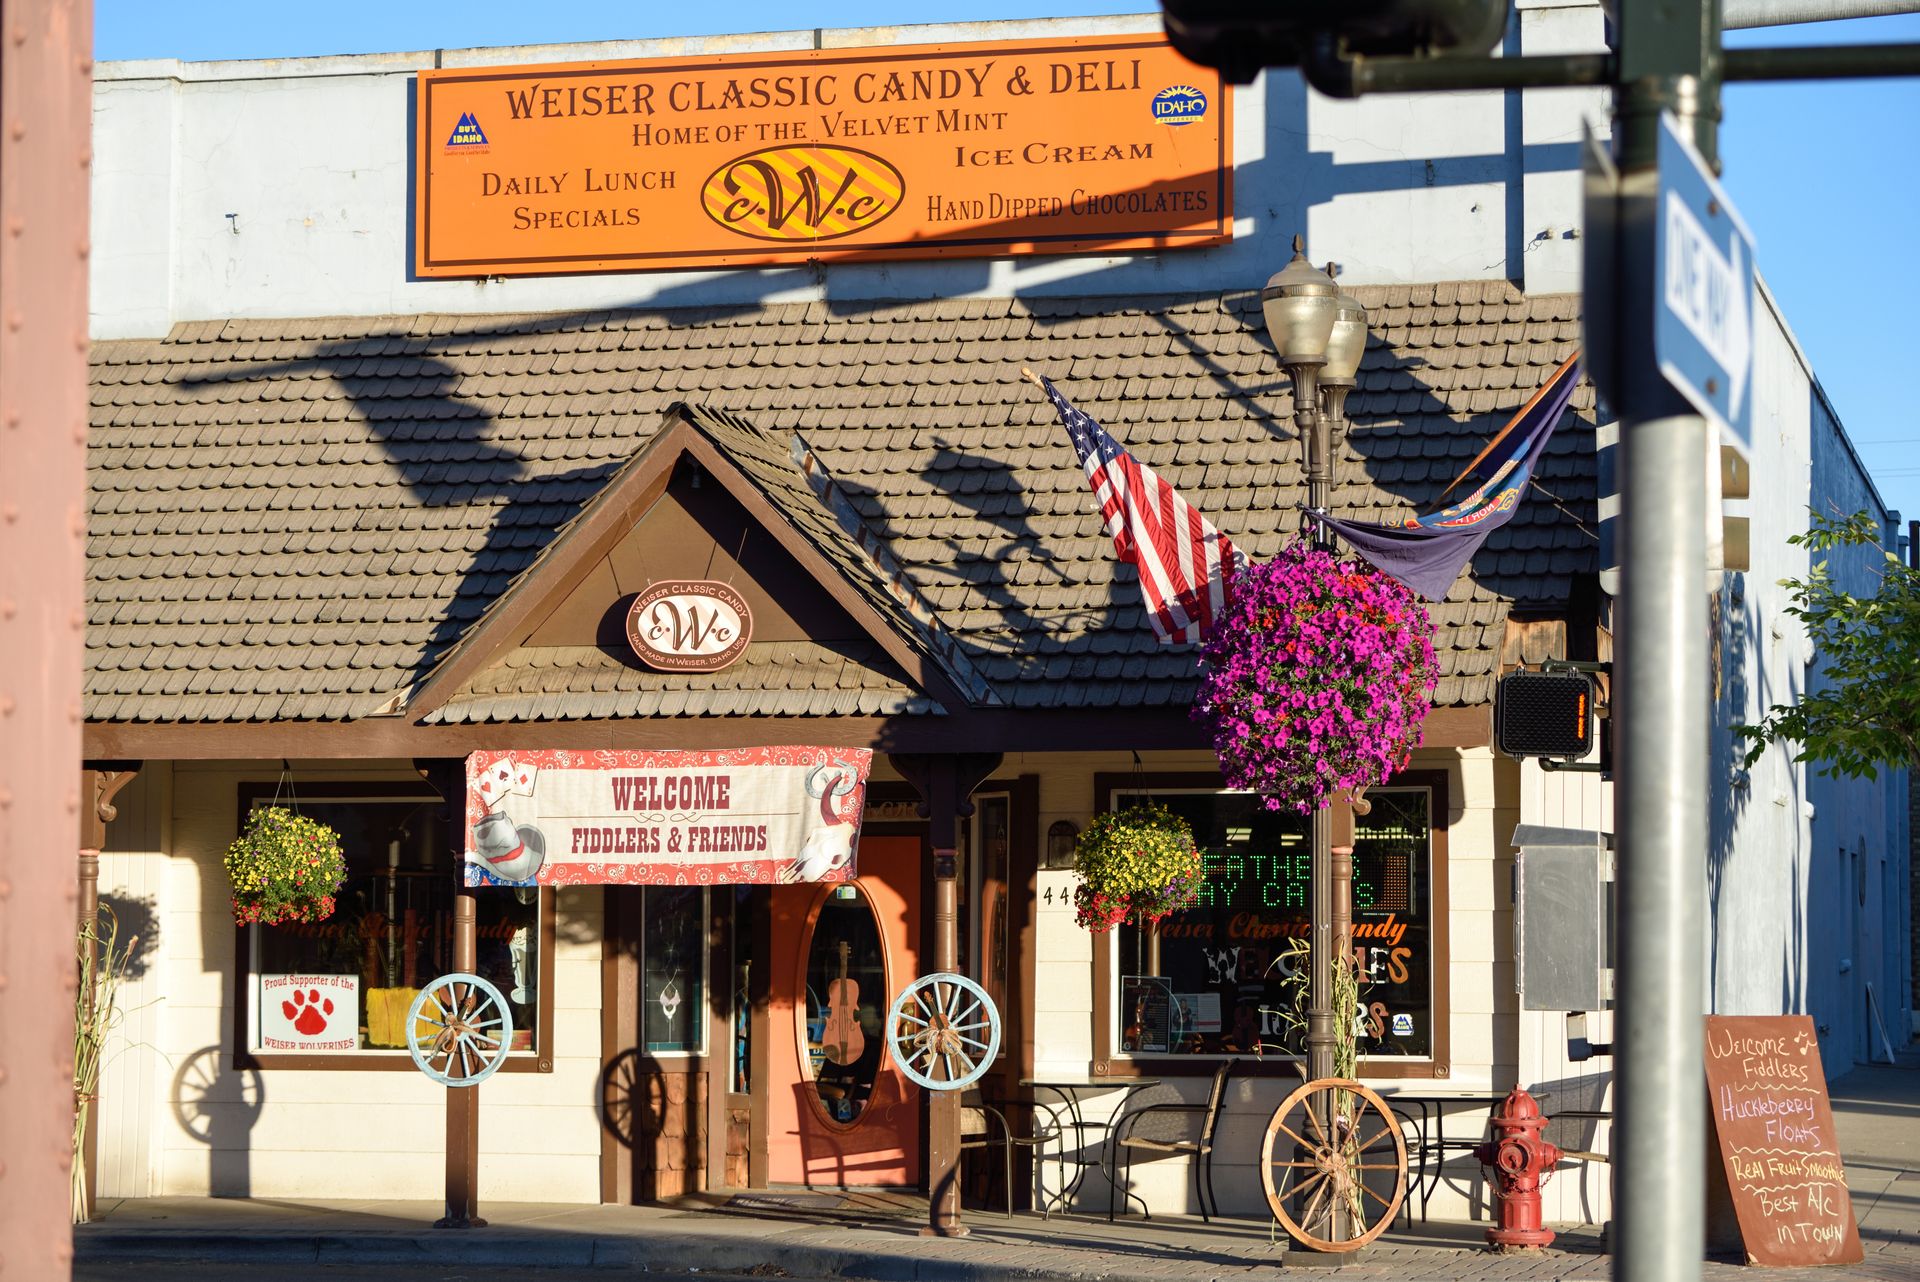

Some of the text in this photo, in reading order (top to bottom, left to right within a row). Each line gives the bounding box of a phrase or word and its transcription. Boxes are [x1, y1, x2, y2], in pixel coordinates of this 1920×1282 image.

[505, 60, 1141, 120] WEISER CLASSIC CANDY & DELI
[1156, 98, 1205, 115] IDAHO
[453, 134, 482, 143] IDAHO
[458, 125, 476, 133] BUY
[633, 109, 1008, 146] HOME OF THE VELVET MINT
[955, 142, 1154, 168] ICE CREAM
[482, 168, 676, 196] DAILY LUNCH
[928, 188, 1208, 221] HAND DIPPED CHOCOLATES
[513, 207, 641, 230] SPECIALS
[633, 585, 748, 618] WEISER CLASSIC CANDY
[631, 633, 646, 651] HAND
[645, 651, 664, 663] MADE
[734, 637, 746, 650] USA
[611, 775, 730, 811] WELCOME
[571, 825, 767, 854] FIDDLERS & FRIENDS
[1263, 882, 1373, 907] CAS
[265, 975, 354, 990] Proud Supporter of the
[264, 1036, 355, 1050] WEISER WOLVERINES
